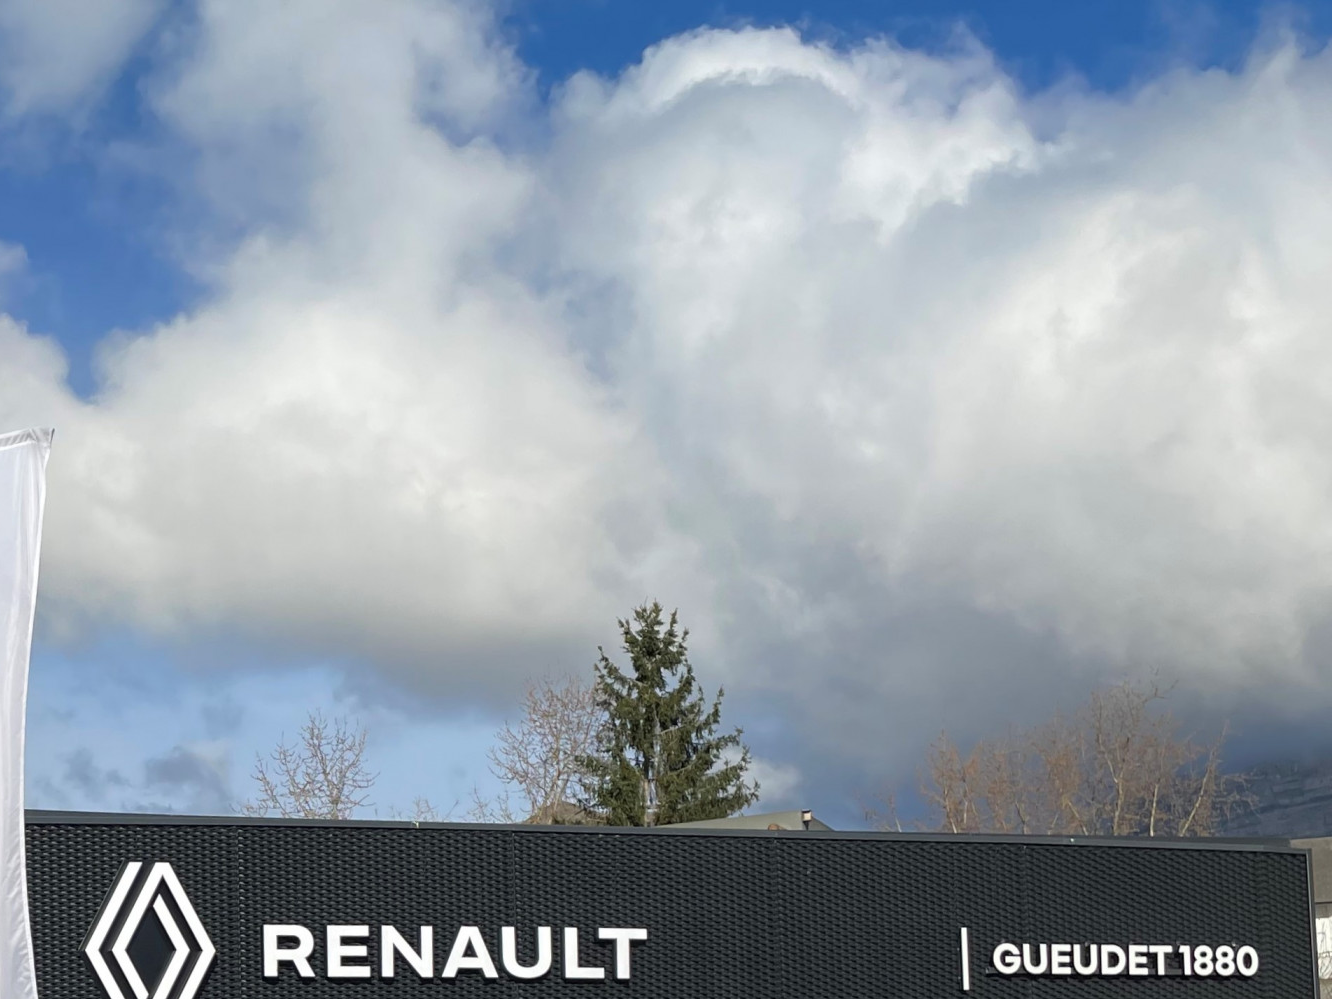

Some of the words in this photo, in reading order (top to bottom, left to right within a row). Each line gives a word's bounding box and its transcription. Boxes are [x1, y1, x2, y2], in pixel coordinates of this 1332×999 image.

[262, 924, 648, 982] RENAULT
[992, 943, 1171, 978] GUEUDET
[1179, 943, 1260, 978] 1880
